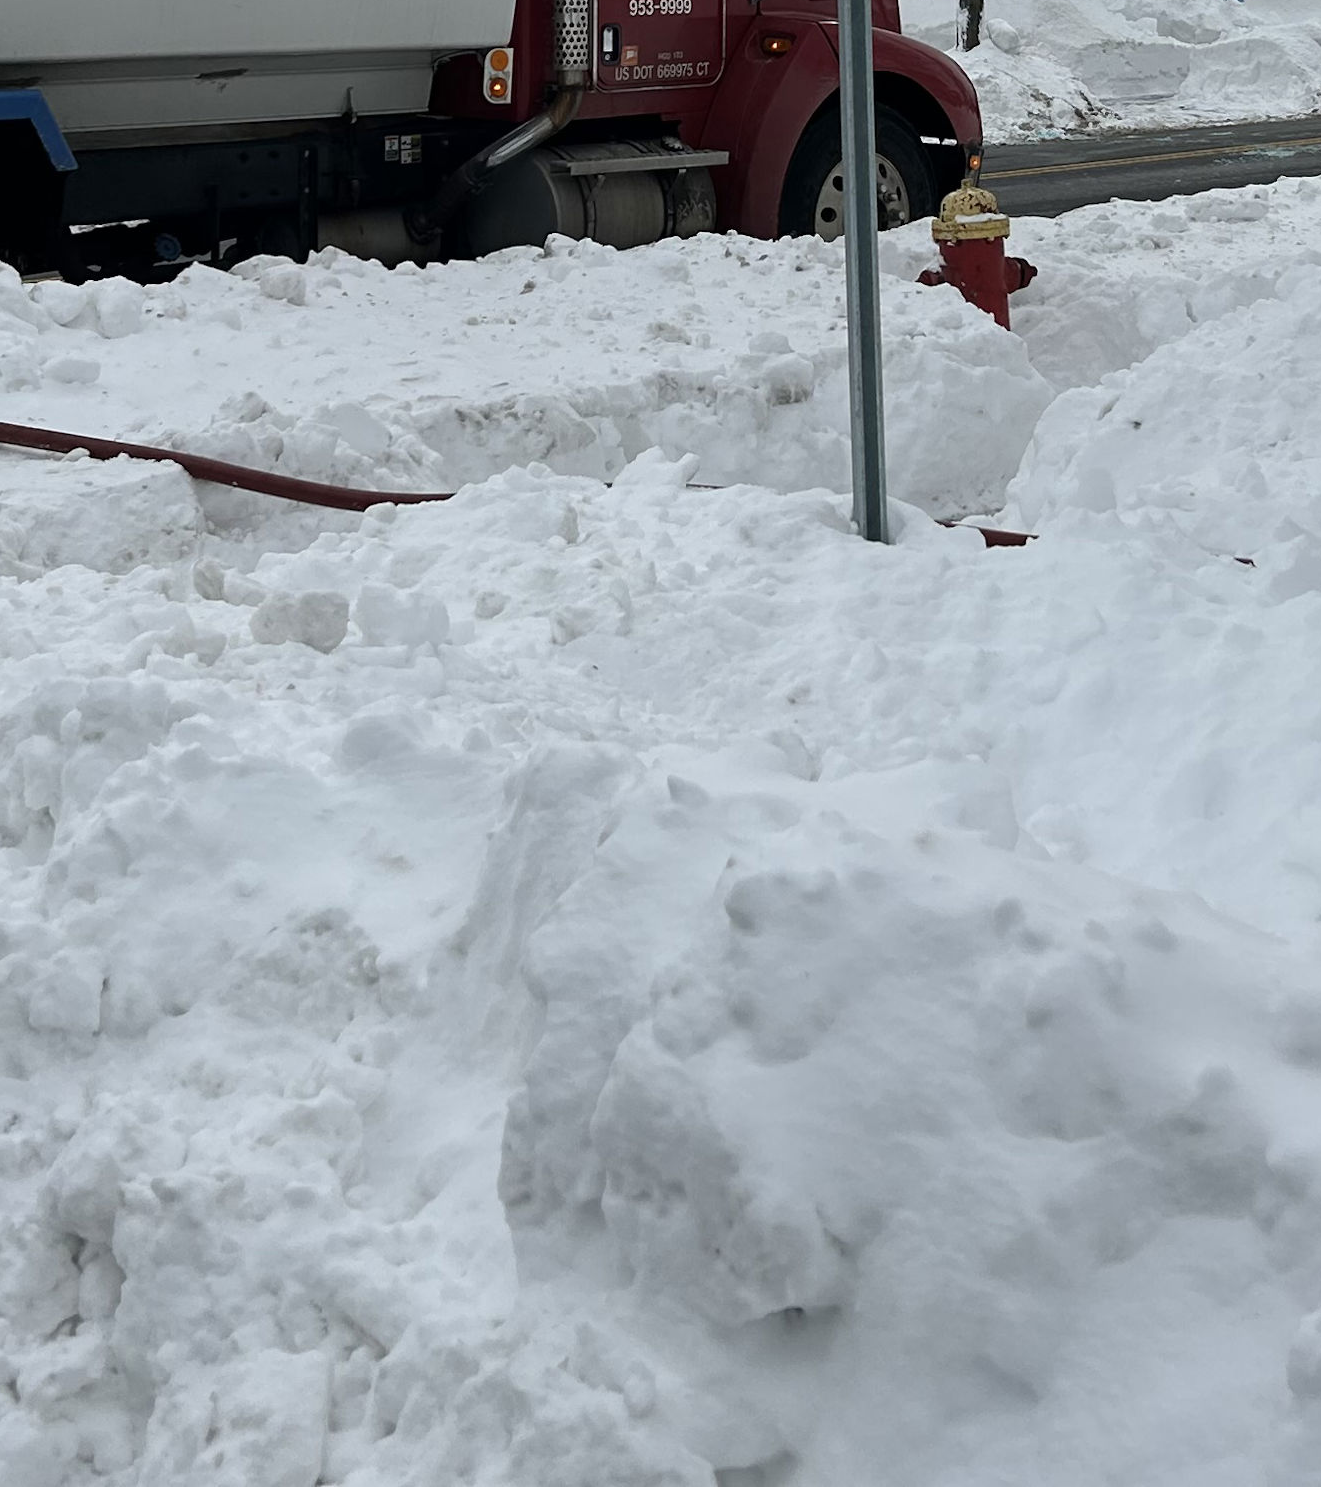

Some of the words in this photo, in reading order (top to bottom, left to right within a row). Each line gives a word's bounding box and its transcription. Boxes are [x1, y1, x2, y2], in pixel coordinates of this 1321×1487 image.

[615, 66, 630, 81] US
[633, 64, 654, 80] DOT
[656, 62, 694, 79] 669975
[696, 61, 710, 76] CT
